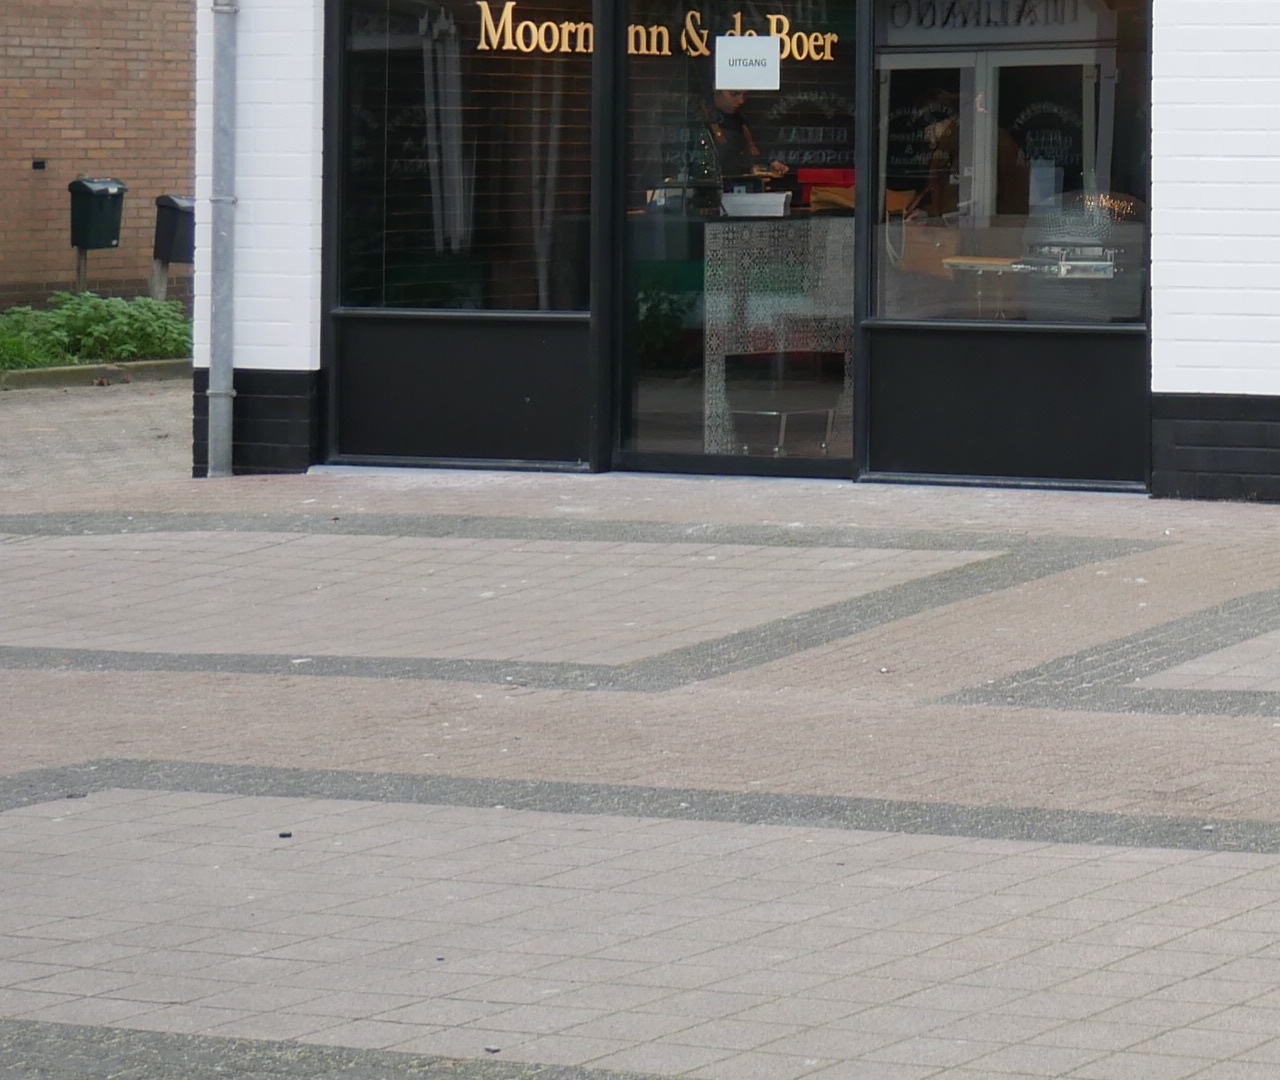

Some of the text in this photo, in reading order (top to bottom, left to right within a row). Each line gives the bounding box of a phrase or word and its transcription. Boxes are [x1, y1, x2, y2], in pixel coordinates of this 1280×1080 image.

[682, 10, 711, 57] &
[766, 14, 838, 61] Boer
[728, 58, 767, 67] UITGANG
